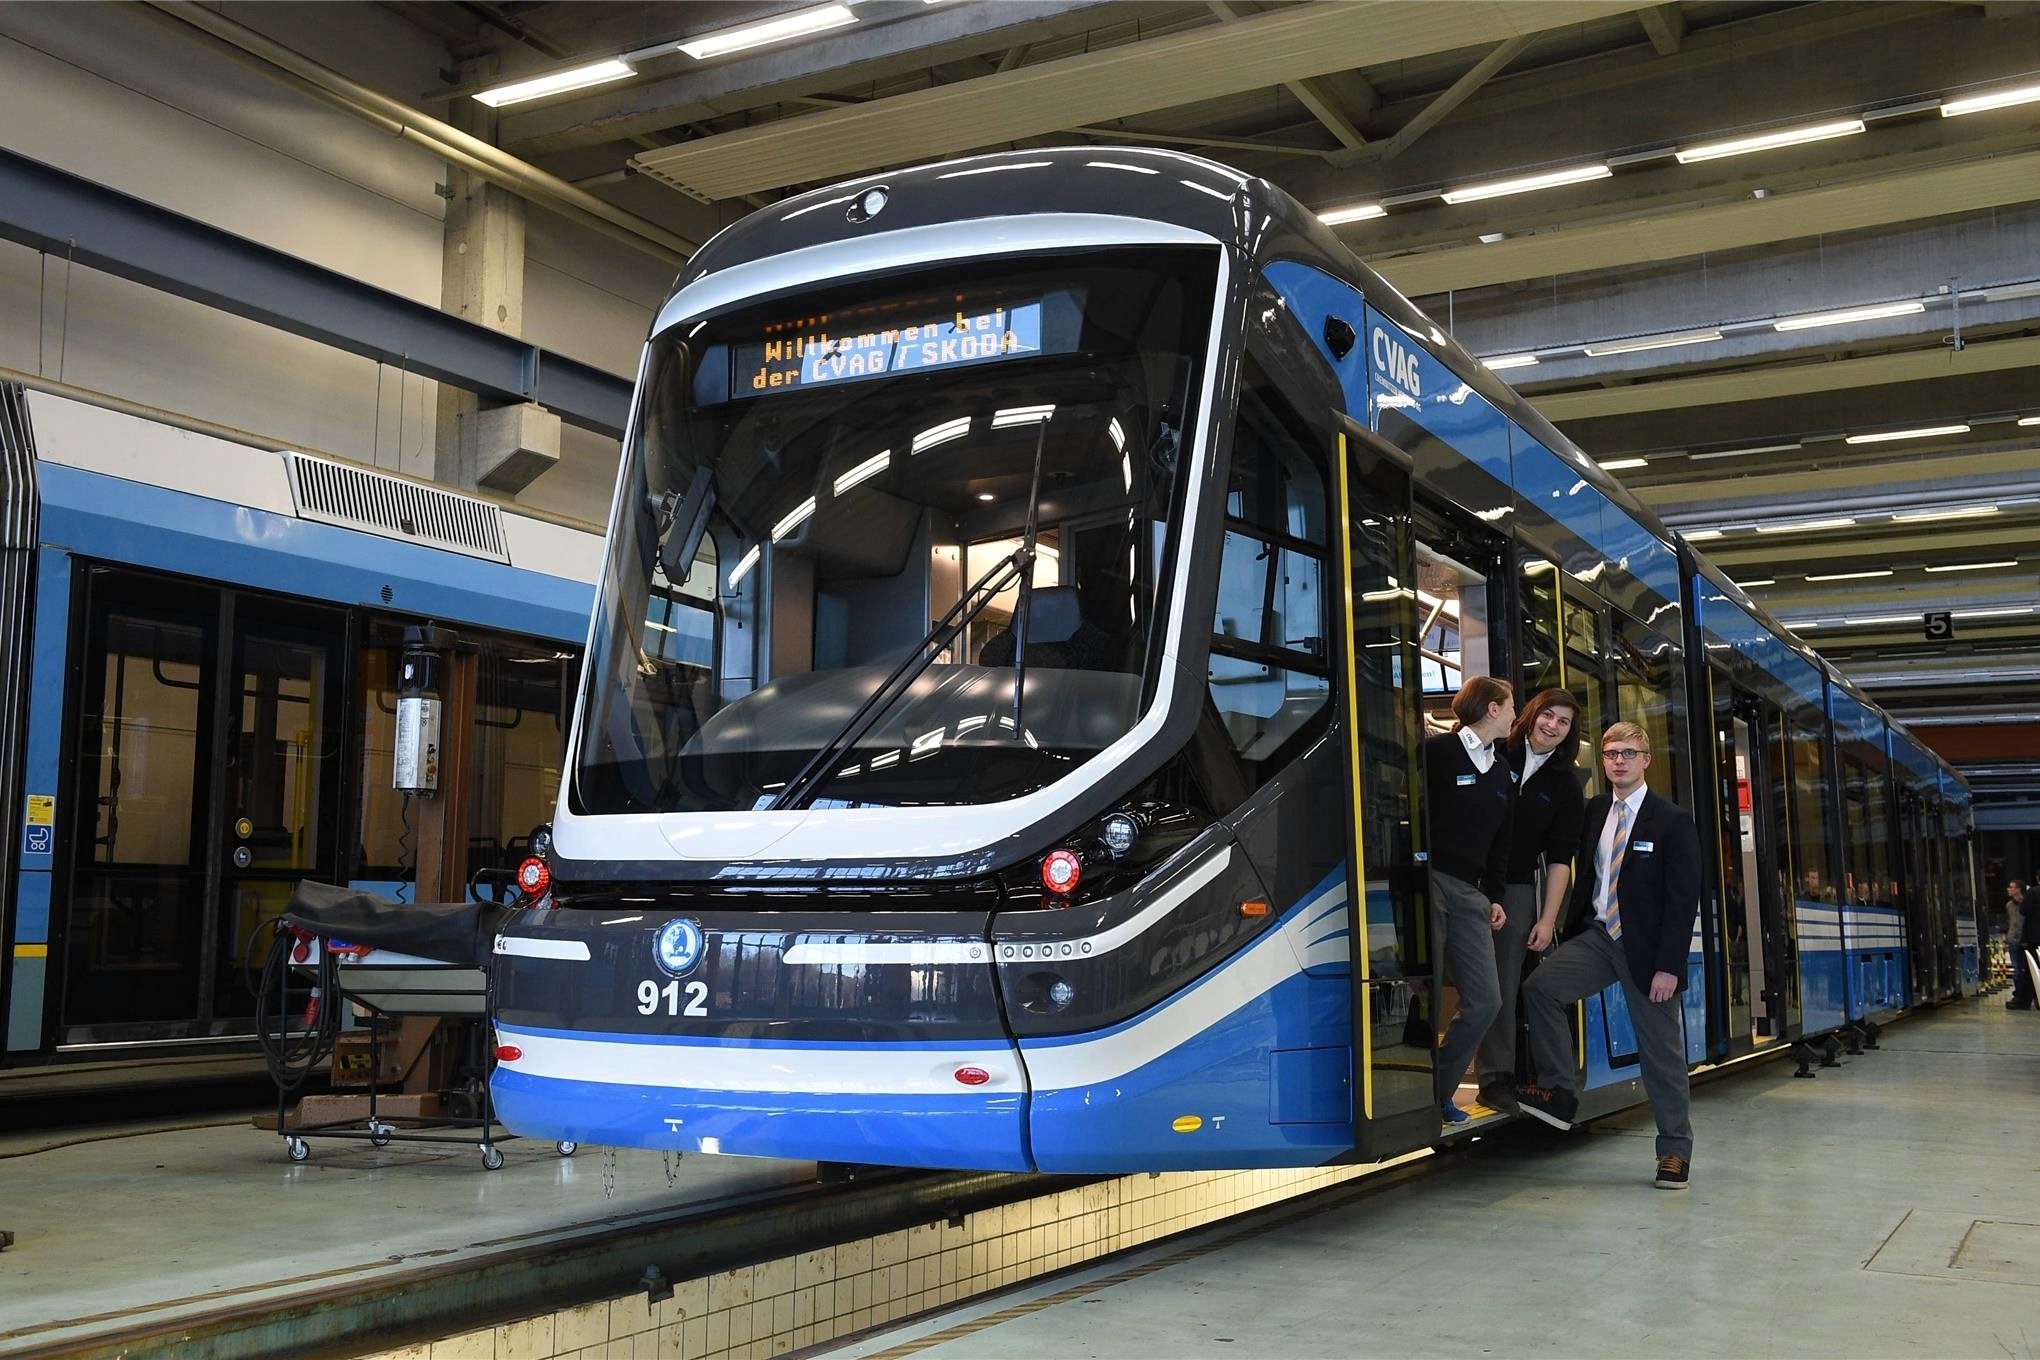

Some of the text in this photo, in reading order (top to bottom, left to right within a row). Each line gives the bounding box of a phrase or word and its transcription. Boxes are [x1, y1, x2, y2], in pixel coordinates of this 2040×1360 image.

[752, 330, 1018, 389] der CVAG / SKODA
[765, 307, 1003, 362] Willkommen bei
[1373, 326, 1421, 397] CVAG
[1930, 613, 1947, 635] 5
[637, 979, 708, 1017] 912
